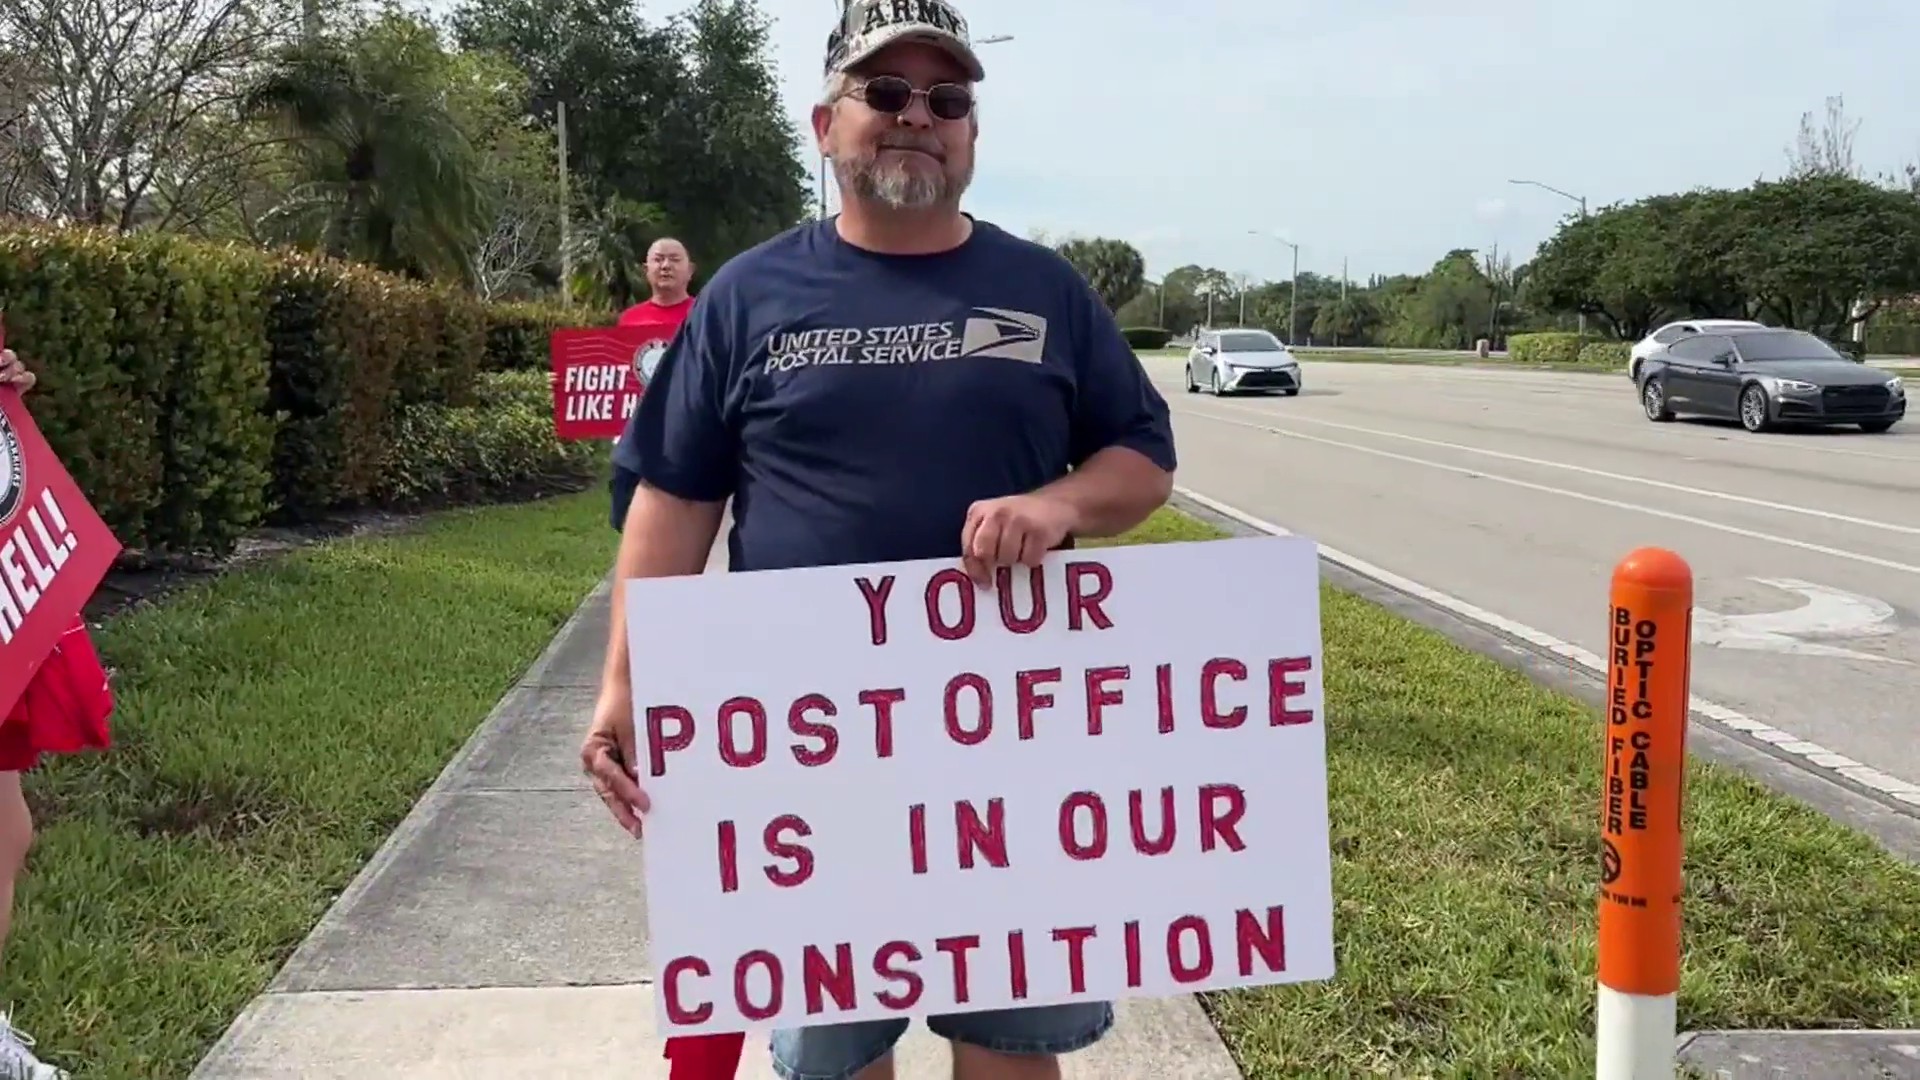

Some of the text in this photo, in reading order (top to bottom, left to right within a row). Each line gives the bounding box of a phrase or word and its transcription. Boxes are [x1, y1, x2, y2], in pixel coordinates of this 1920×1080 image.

[862, 0, 962, 35] ARMY
[564, 364, 631, 393] FIGHT
[763, 339, 963, 375] POSTAL SERVICE
[767, 322, 955, 356] UNITED STATES
[565, 394, 615, 421] LIKE
[855, 561, 1113, 646] YOUR
[646, 656, 1314, 777] POST OFFICE
[1608, 607, 1630, 835] BURIED FIBER
[1629, 619, 1657, 830] OPTIC CABLE
[717, 783, 1247, 893] IS IN OUR
[662, 904, 1286, 1026] CONSTITION
